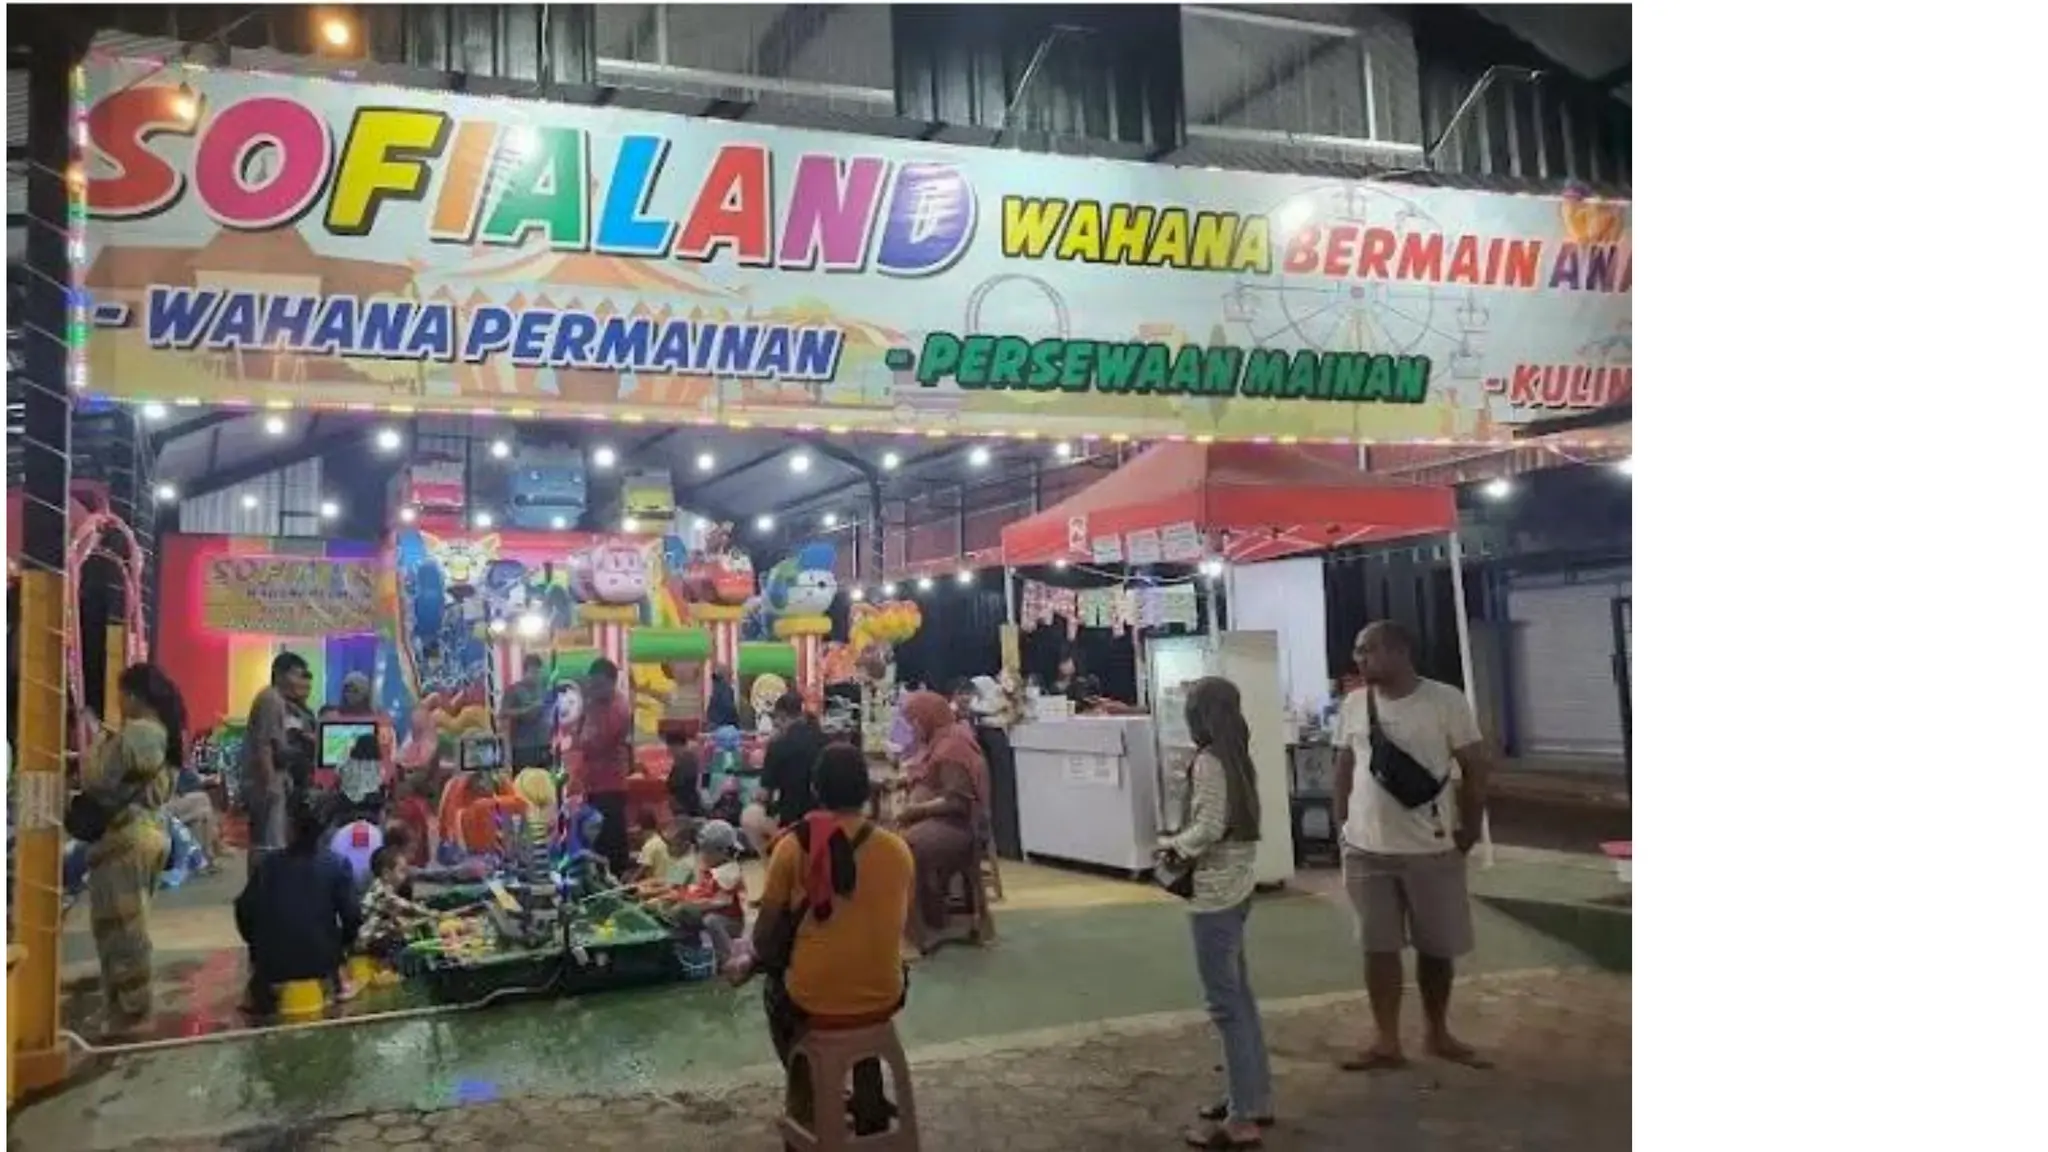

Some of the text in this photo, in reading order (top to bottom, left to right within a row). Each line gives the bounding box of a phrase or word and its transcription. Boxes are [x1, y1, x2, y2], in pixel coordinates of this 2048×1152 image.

[84, 85, 978, 276] SOFIALAND
[1001, 195, 1273, 273] WAHANA
[1283, 224, 1542, 287] BERMAIN
[146, 286, 456, 359] WAHANA
[465, 305, 845, 382] PERMAINAN
[917, 331, 1243, 394] PERSEWAAN
